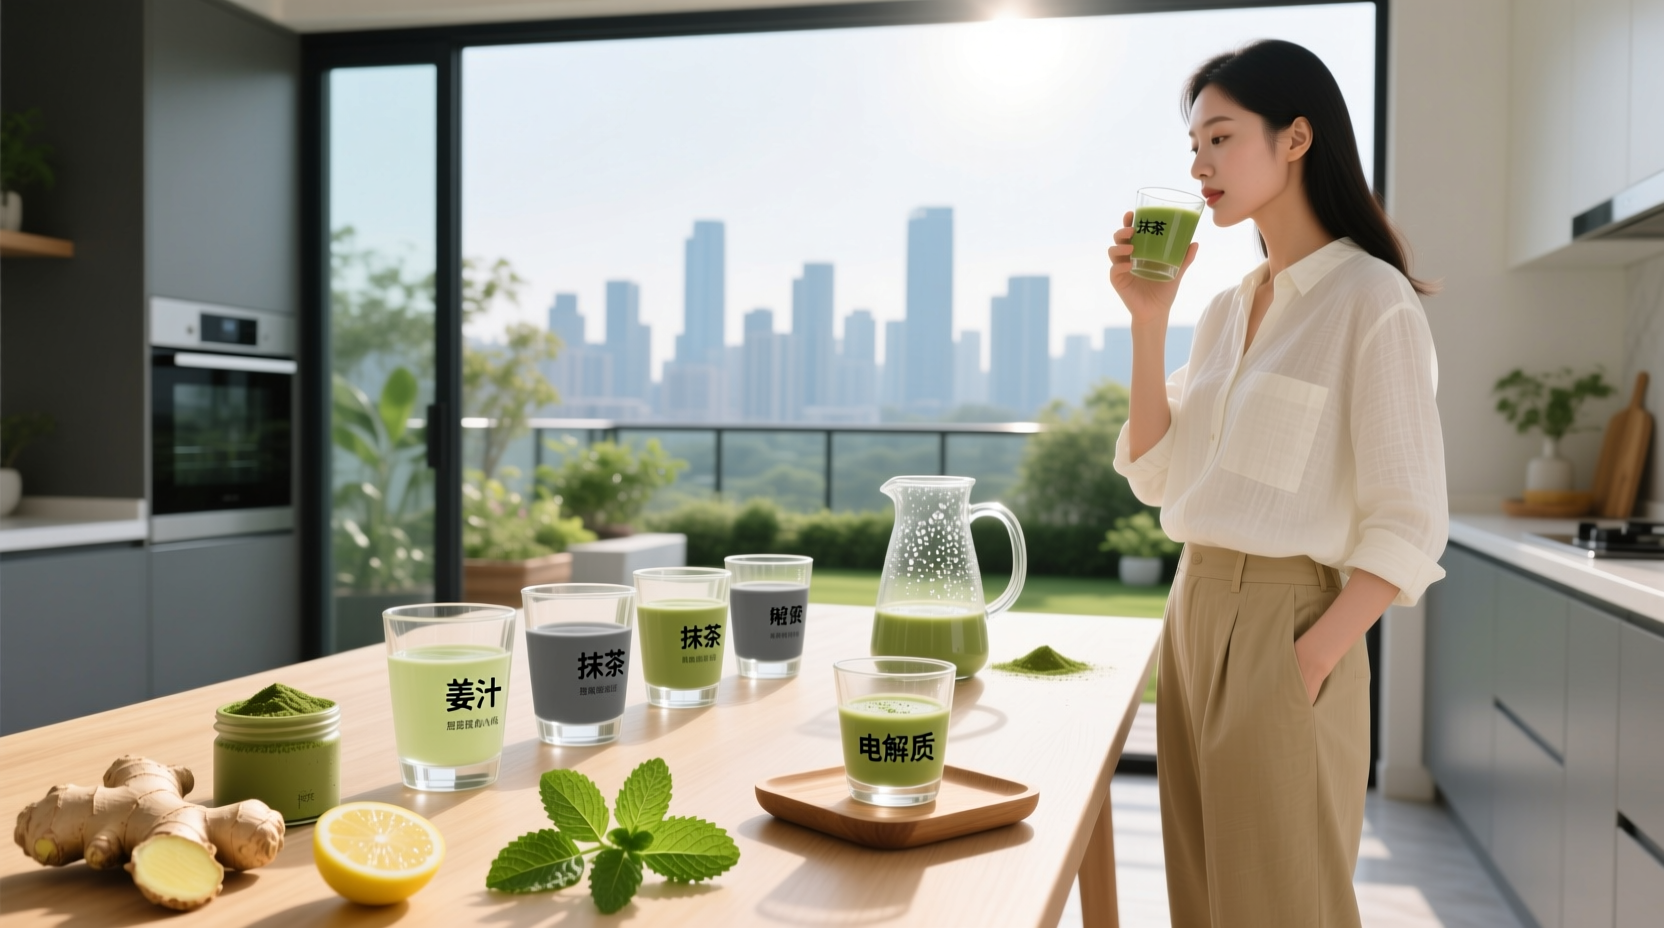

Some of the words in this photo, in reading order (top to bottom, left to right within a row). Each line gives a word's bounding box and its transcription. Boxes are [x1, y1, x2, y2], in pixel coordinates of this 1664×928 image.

[680, 623, 722, 650] 抹茶
[577, 648, 626, 680] 抹茶
[445, 676, 502, 712] 姜汁
[859, 731, 935, 763] 电解质
